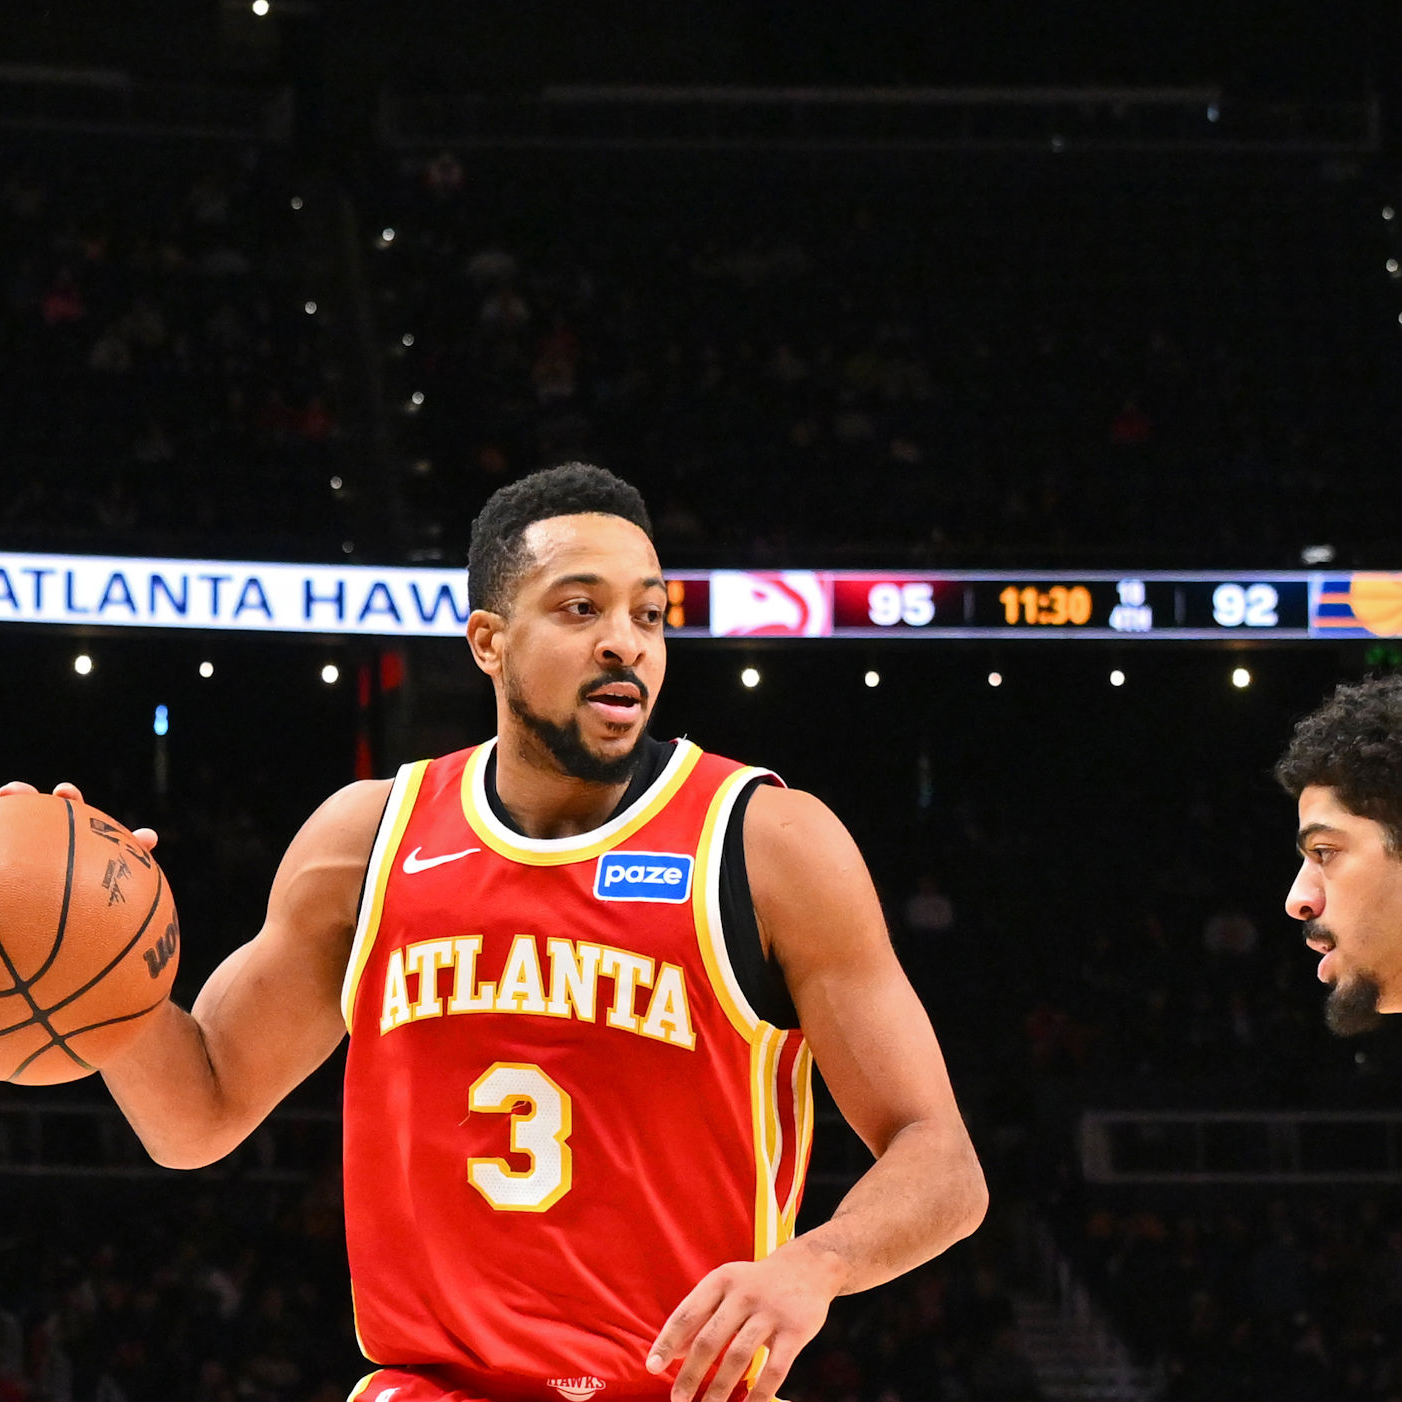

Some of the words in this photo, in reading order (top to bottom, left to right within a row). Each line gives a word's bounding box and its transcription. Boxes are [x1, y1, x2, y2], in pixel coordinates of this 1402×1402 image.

[303, 577, 468, 625] HAW
[868, 583, 935, 626] 95
[999, 585, 1093, 625] 11:30
[1213, 583, 1279, 627] 92
[604, 863, 683, 888] paze
[379, 934, 696, 1051] ATLANTA
[466, 1061, 573, 1213] 3
[546, 1375, 606, 1390] HAWKS
